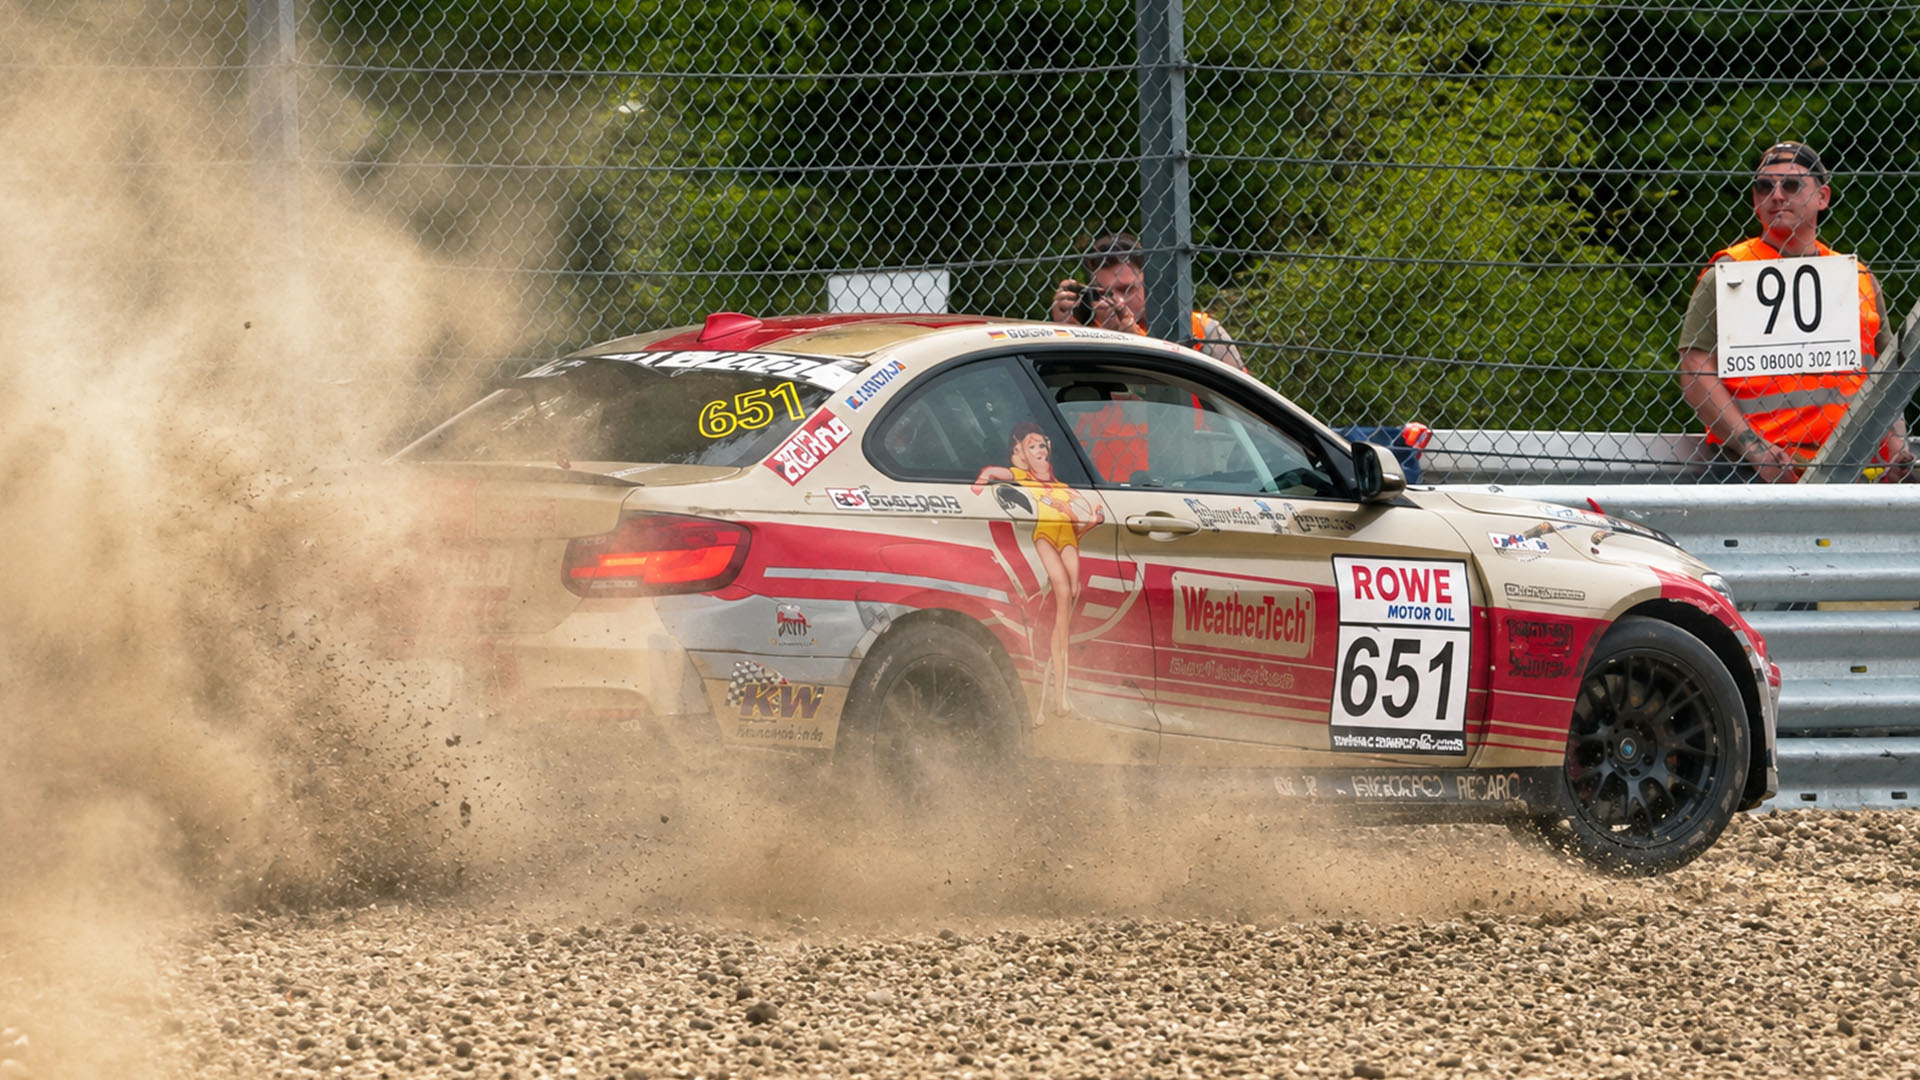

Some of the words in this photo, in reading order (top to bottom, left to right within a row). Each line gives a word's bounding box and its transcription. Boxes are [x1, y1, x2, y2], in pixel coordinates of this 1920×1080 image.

[1756, 264, 1822, 335] 90
[1726, 355, 1756, 372] SOS
[1760, 352, 1804, 370] 08000
[1808, 351, 1832, 368] 302
[1836, 349, 1857, 366] 112
[698, 381, 806, 439] 651
[1351, 565, 1453, 604] ROWE
[1180, 585, 1307, 644] WeatherTech
[1387, 604, 1432, 620] MOTOR
[1435, 606, 1455, 622] OIL
[739, 682, 825, 720] KW
[1340, 636, 1455, 721] 651
